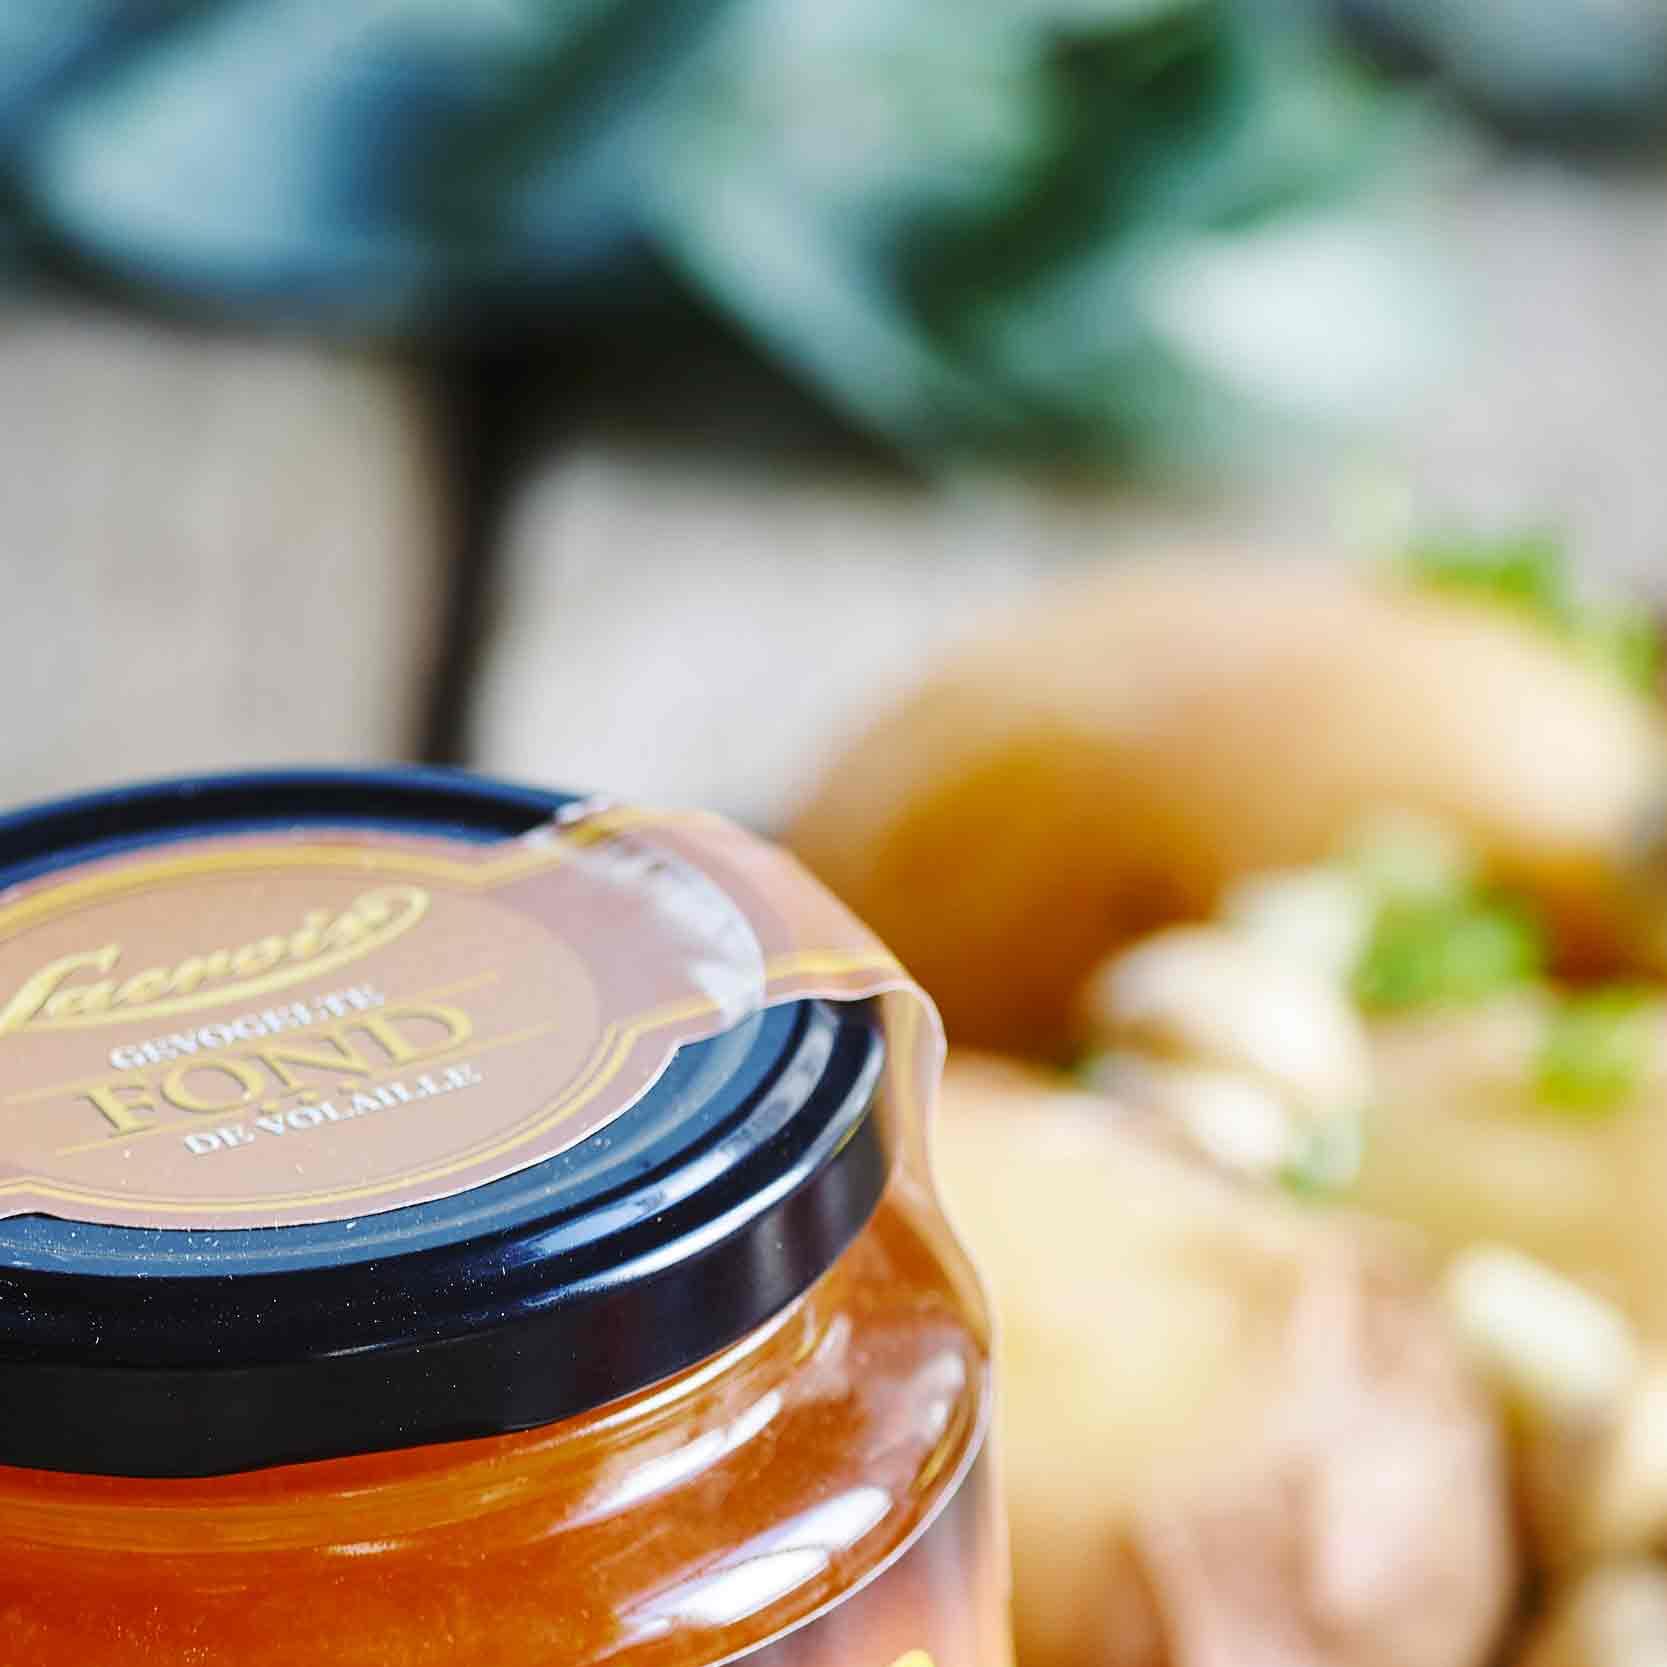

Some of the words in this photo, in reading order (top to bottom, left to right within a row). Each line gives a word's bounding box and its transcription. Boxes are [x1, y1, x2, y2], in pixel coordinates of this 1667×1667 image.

[83, 1003, 474, 1138] FOND
[184, 1121, 256, 1157] DE
[255, 1063, 483, 1138] VOLAILLE
